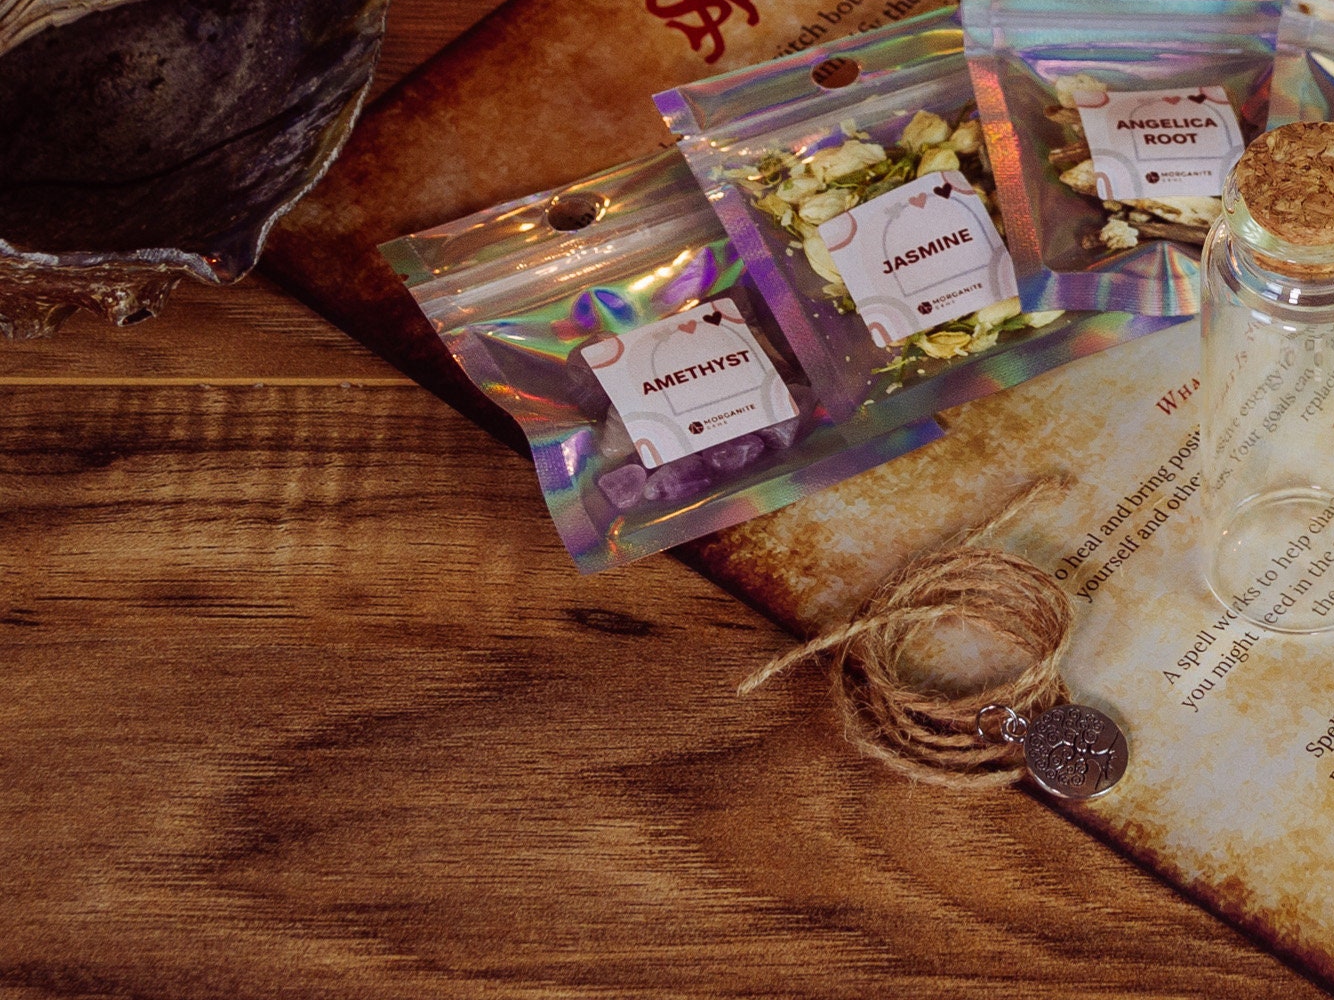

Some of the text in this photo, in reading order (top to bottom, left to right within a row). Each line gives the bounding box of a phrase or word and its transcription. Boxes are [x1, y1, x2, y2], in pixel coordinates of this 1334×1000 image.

[1116, 117, 1218, 131] ANGELICA
[1143, 133, 1198, 145] ROOT
[1160, 170, 1213, 178] MORGANITE
[882, 228, 973, 274] JASMINE
[932, 282, 983, 305] MORGANITE
[642, 350, 750, 396] AMETHYST
[703, 403, 757, 426] MORGANITE
[1063, 464, 1176, 570] heal and bring
[1076, 508, 1169, 603] yourself and
[1162, 669, 1181, 685] A
[1177, 630, 1217, 671] spell
[1256, 569, 1279, 587] to
[1272, 533, 1310, 570] help
[1181, 678, 1216, 713] you
[1212, 631, 1260, 679] might
[1288, 577, 1313, 596] in
